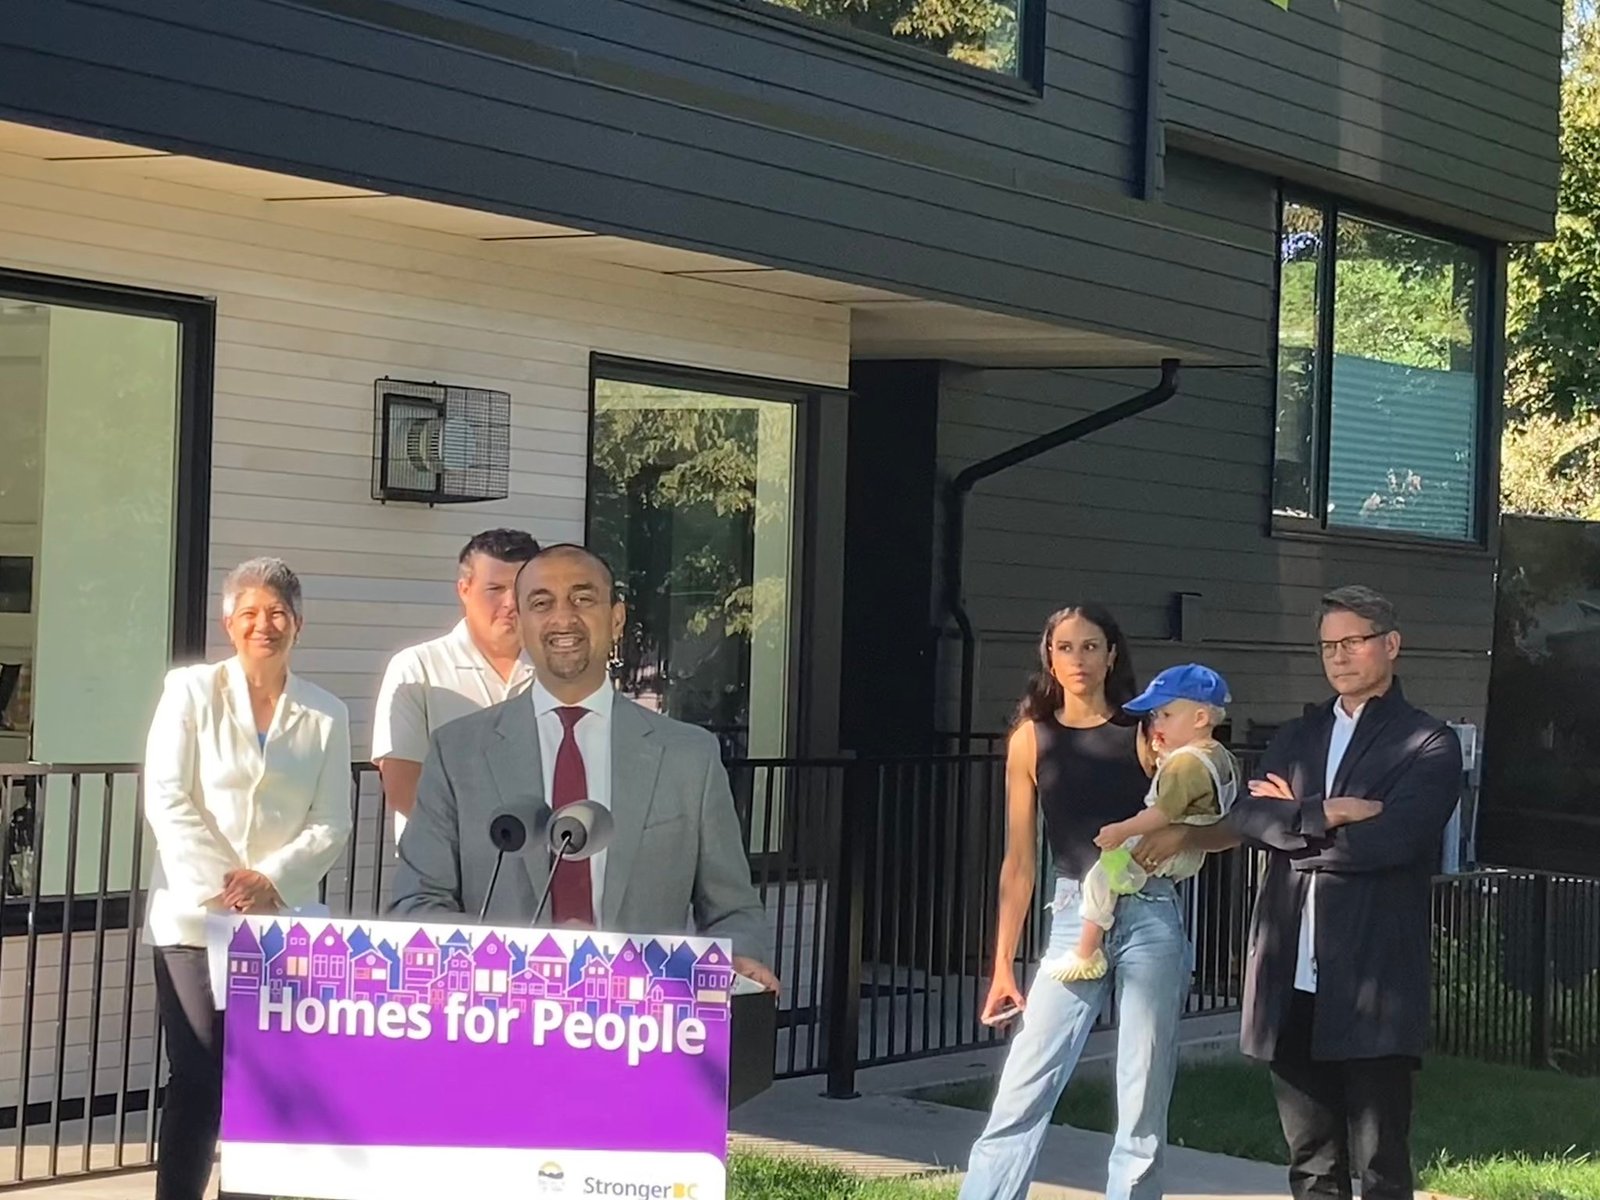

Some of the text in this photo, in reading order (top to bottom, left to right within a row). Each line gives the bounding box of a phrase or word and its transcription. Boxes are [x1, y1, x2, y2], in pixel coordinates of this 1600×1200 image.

[258, 985, 707, 1067] Homes for People
[584, 1177, 699, 1200] StrongerBC
